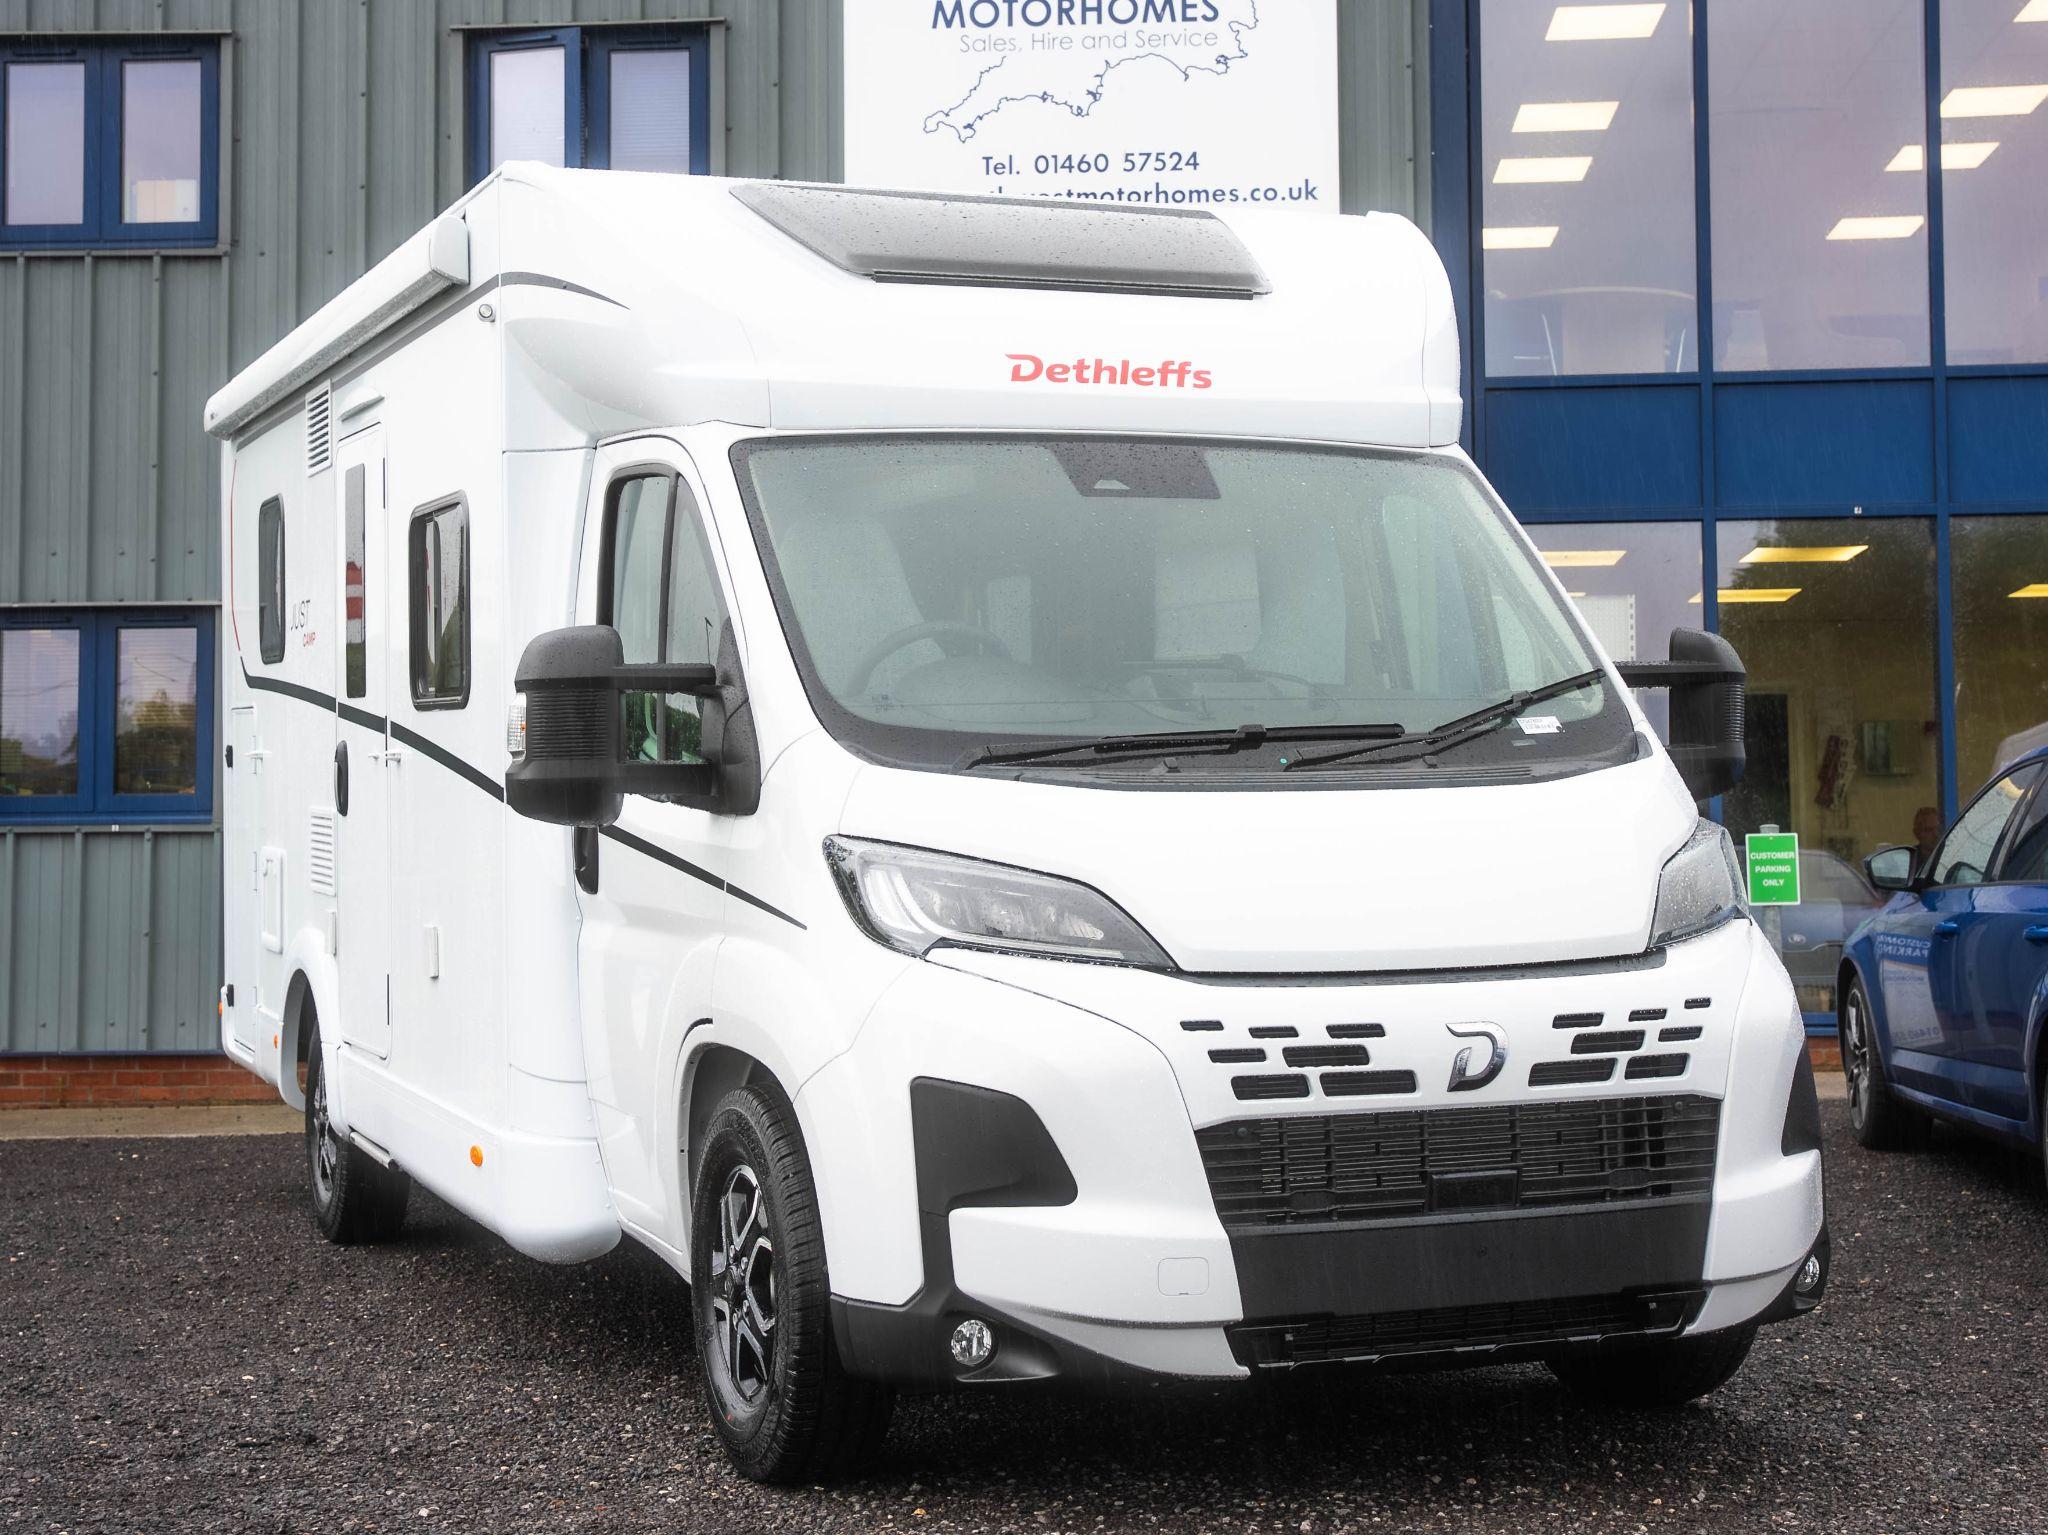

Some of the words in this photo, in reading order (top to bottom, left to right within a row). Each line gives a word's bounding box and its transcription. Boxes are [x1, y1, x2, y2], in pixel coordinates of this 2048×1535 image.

[931, 0, 1220, 29] MOTORHOMES
[960, 34, 1022, 53] Sales,
[1031, 32, 1074, 51] Hire
[1081, 31, 1128, 49] and
[1135, 28, 1218, 48] Service
[982, 154, 1021, 175] Tel.
[1034, 153, 1109, 174] 01460
[1122, 151, 1200, 172] 57524
[1004, 353, 1212, 389] Dethleffs
[290, 599, 311, 631] JUST
[1750, 851, 1795, 860] CUSTOMER
[1754, 865, 1791, 873] PARKING
[1762, 879, 1785, 887] ONLY
